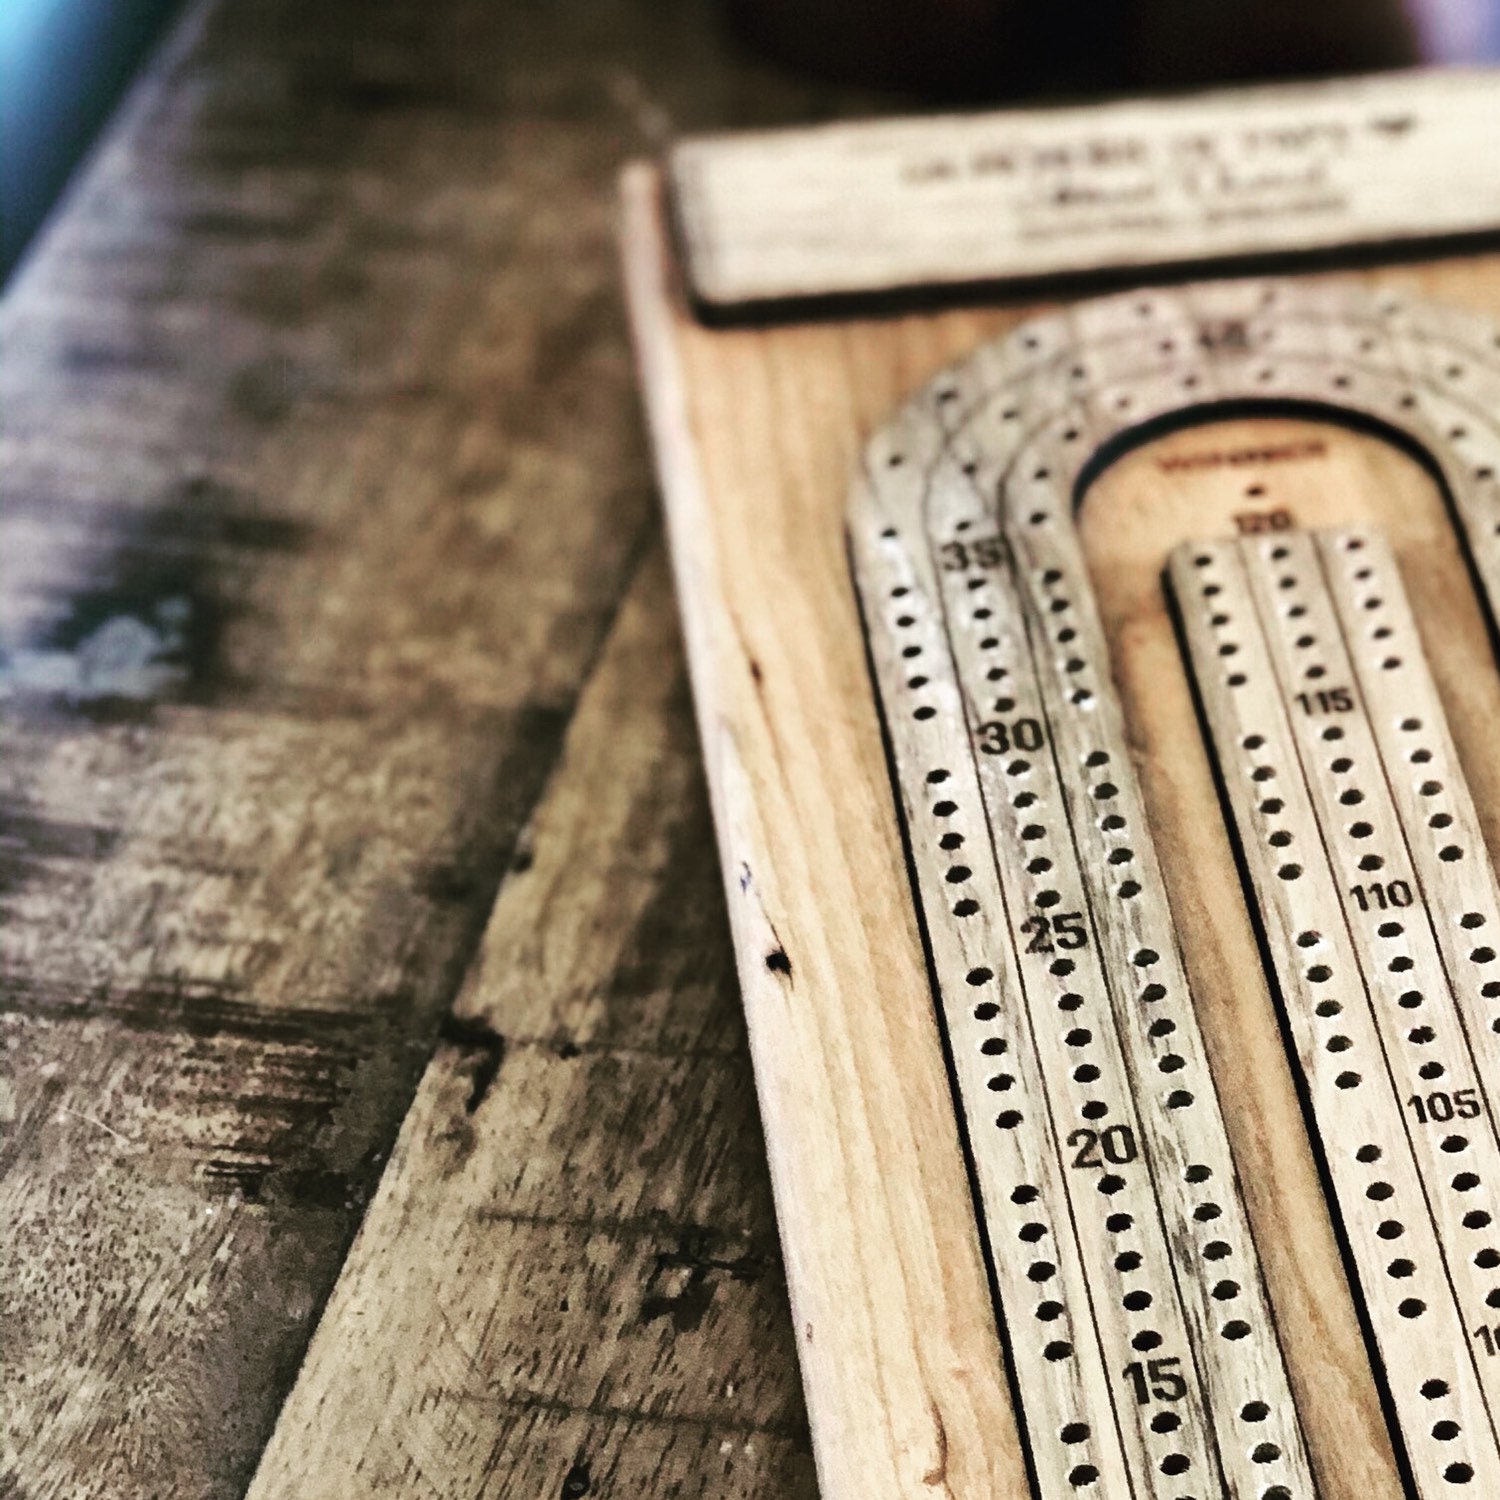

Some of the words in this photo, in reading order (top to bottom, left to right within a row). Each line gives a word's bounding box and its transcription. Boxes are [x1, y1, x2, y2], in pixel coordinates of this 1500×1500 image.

[941, 537, 1002, 573] 35
[1296, 687, 1355, 718] 115
[977, 718, 1045, 756] 30
[1349, 879, 1415, 912] 110
[1020, 912, 1088, 955] 25
[1407, 1088, 1482, 1125] 105
[1067, 1124, 1139, 1169] 20
[1122, 1356, 1188, 1405] 15
